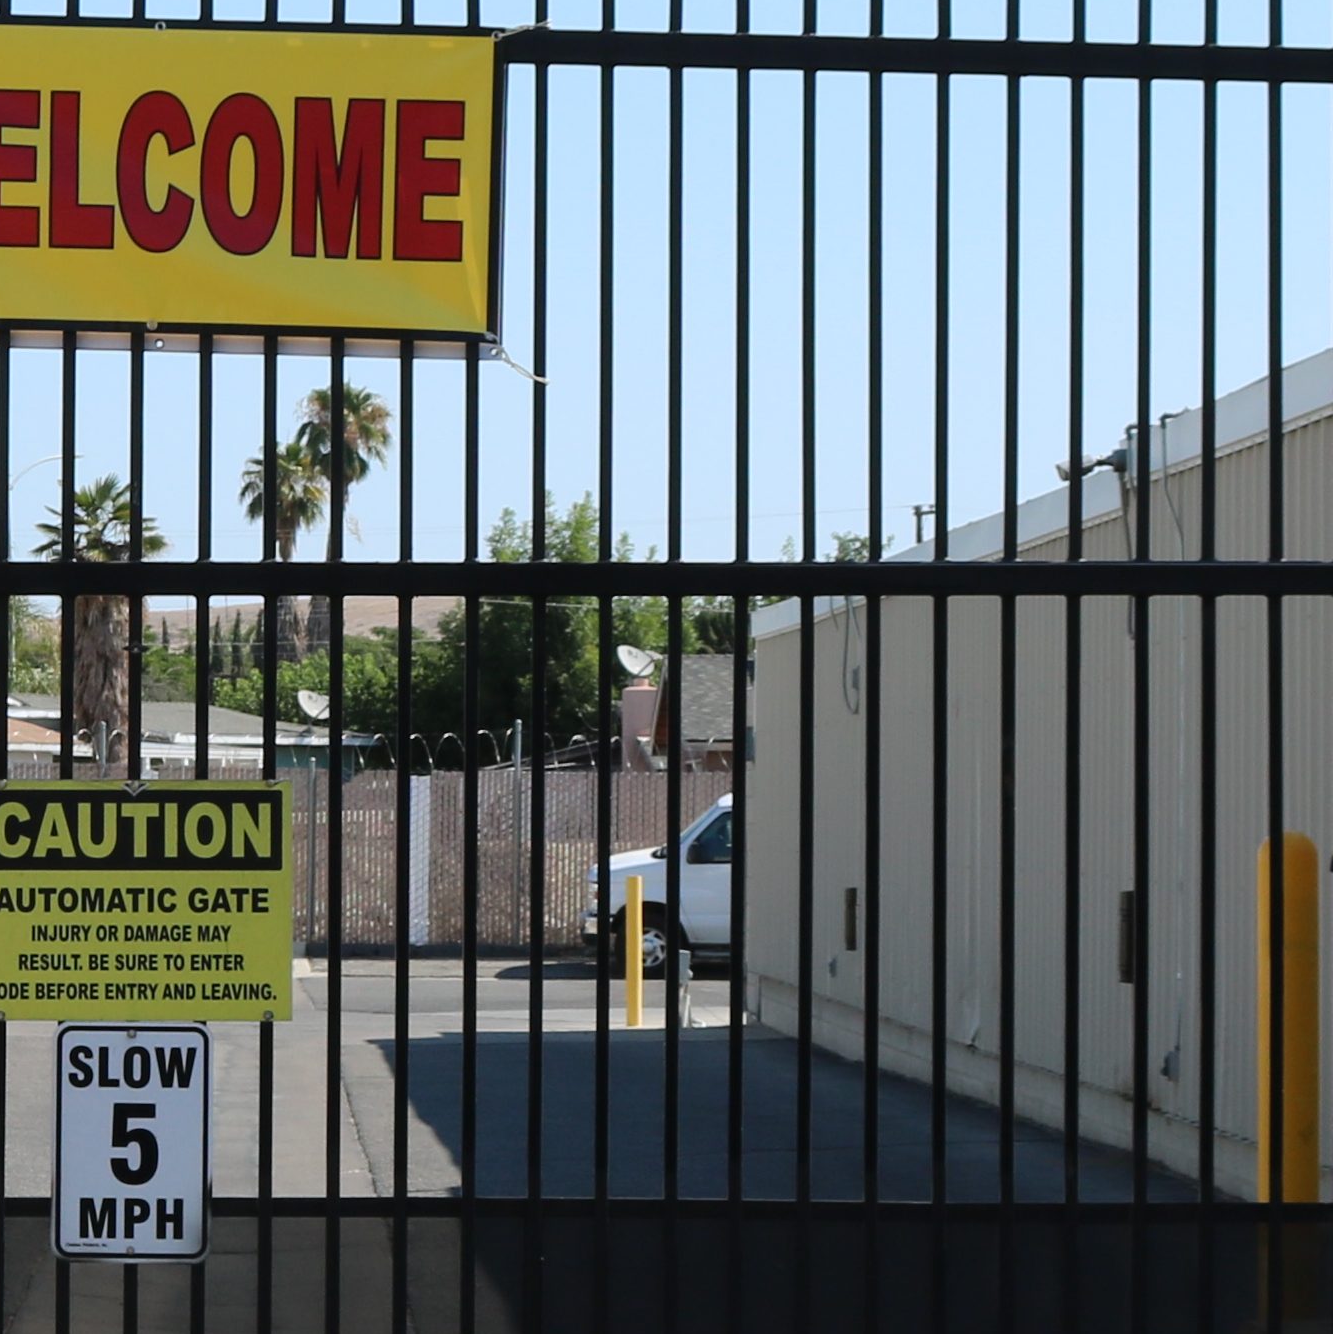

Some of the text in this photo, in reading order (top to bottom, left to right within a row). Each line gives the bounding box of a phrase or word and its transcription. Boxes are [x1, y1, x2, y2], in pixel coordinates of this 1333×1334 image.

[188, 887, 270, 913] GATE
[31, 924, 232, 942] INJURY OR DAMAGE MAY
[18, 954, 245, 971] RESULT. BE SURE TO ENTER
[35, 983, 99, 1000] BEFORE
[104, 983, 158, 1000] ENTRY
[162, 983, 196, 1000] AND
[202, 983, 277, 1001] LEAVING.
[68, 1045, 198, 1089] SLOW
[110, 1102, 159, 1186] 5
[79, 1197, 184, 1240] MPH
